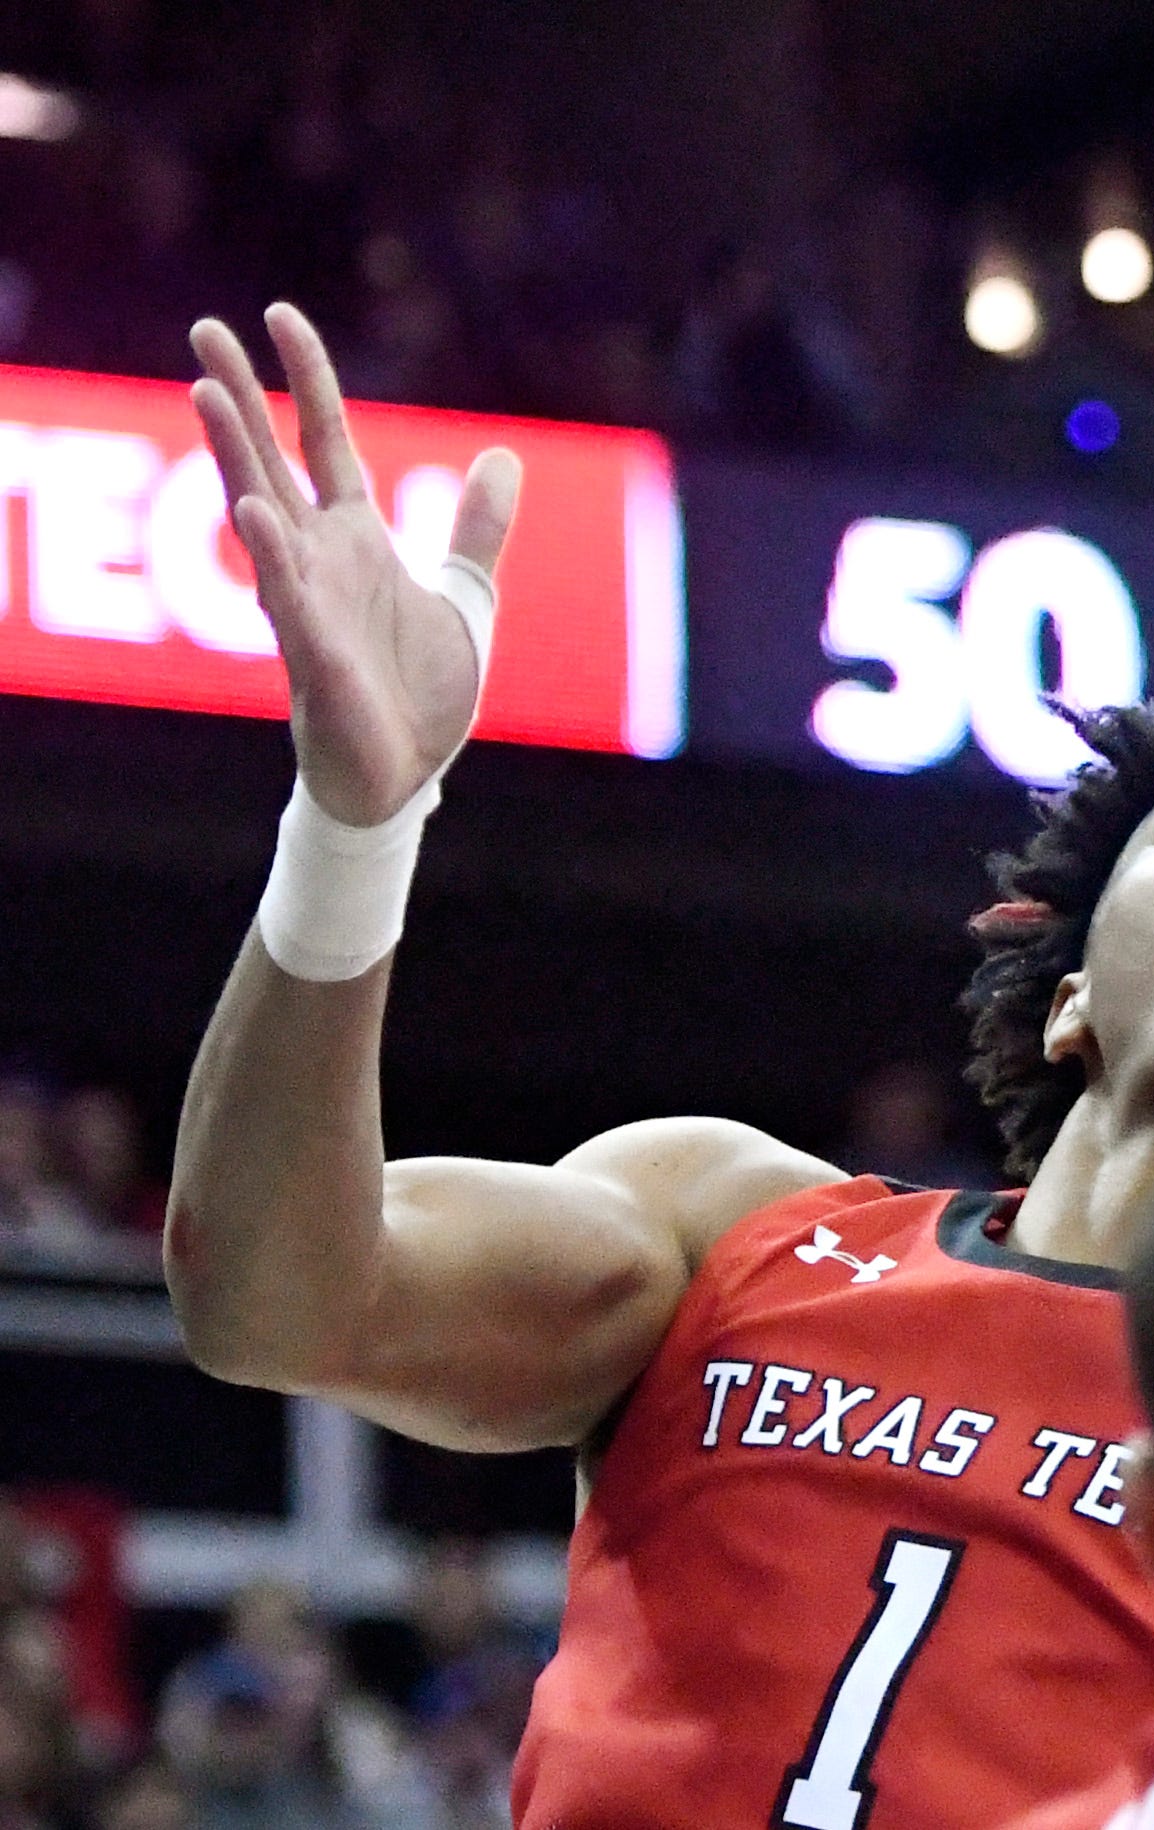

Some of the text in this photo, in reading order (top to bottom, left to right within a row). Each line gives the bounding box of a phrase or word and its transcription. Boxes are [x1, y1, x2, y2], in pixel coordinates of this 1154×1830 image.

[808, 516, 1147, 790] 50
[701, 1358, 996, 1479] TEXAS
[770, 1527, 965, 1830] 1
